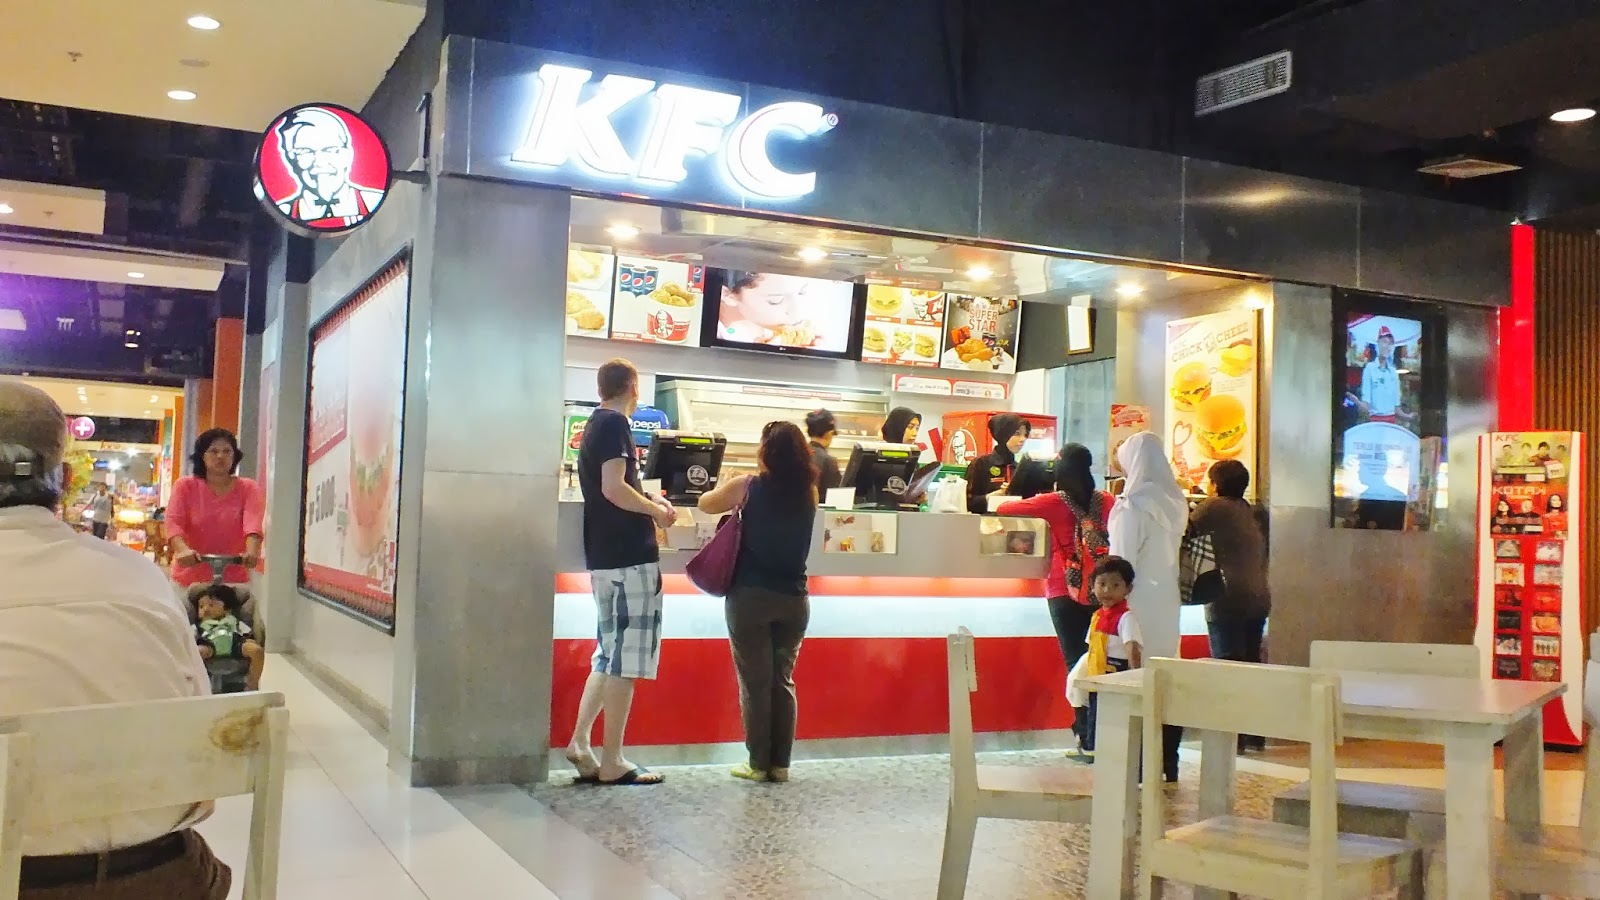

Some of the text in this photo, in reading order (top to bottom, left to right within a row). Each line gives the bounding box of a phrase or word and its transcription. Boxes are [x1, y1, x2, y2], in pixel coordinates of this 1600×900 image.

[511, 63, 823, 198] KFC
[969, 307, 998, 320] SUPER
[968, 318, 997, 333] STAR
[1171, 341, 1203, 362] CHICK
[1216, 322, 1249, 344] CHEEZ
[633, 419, 661, 430] pepsi
